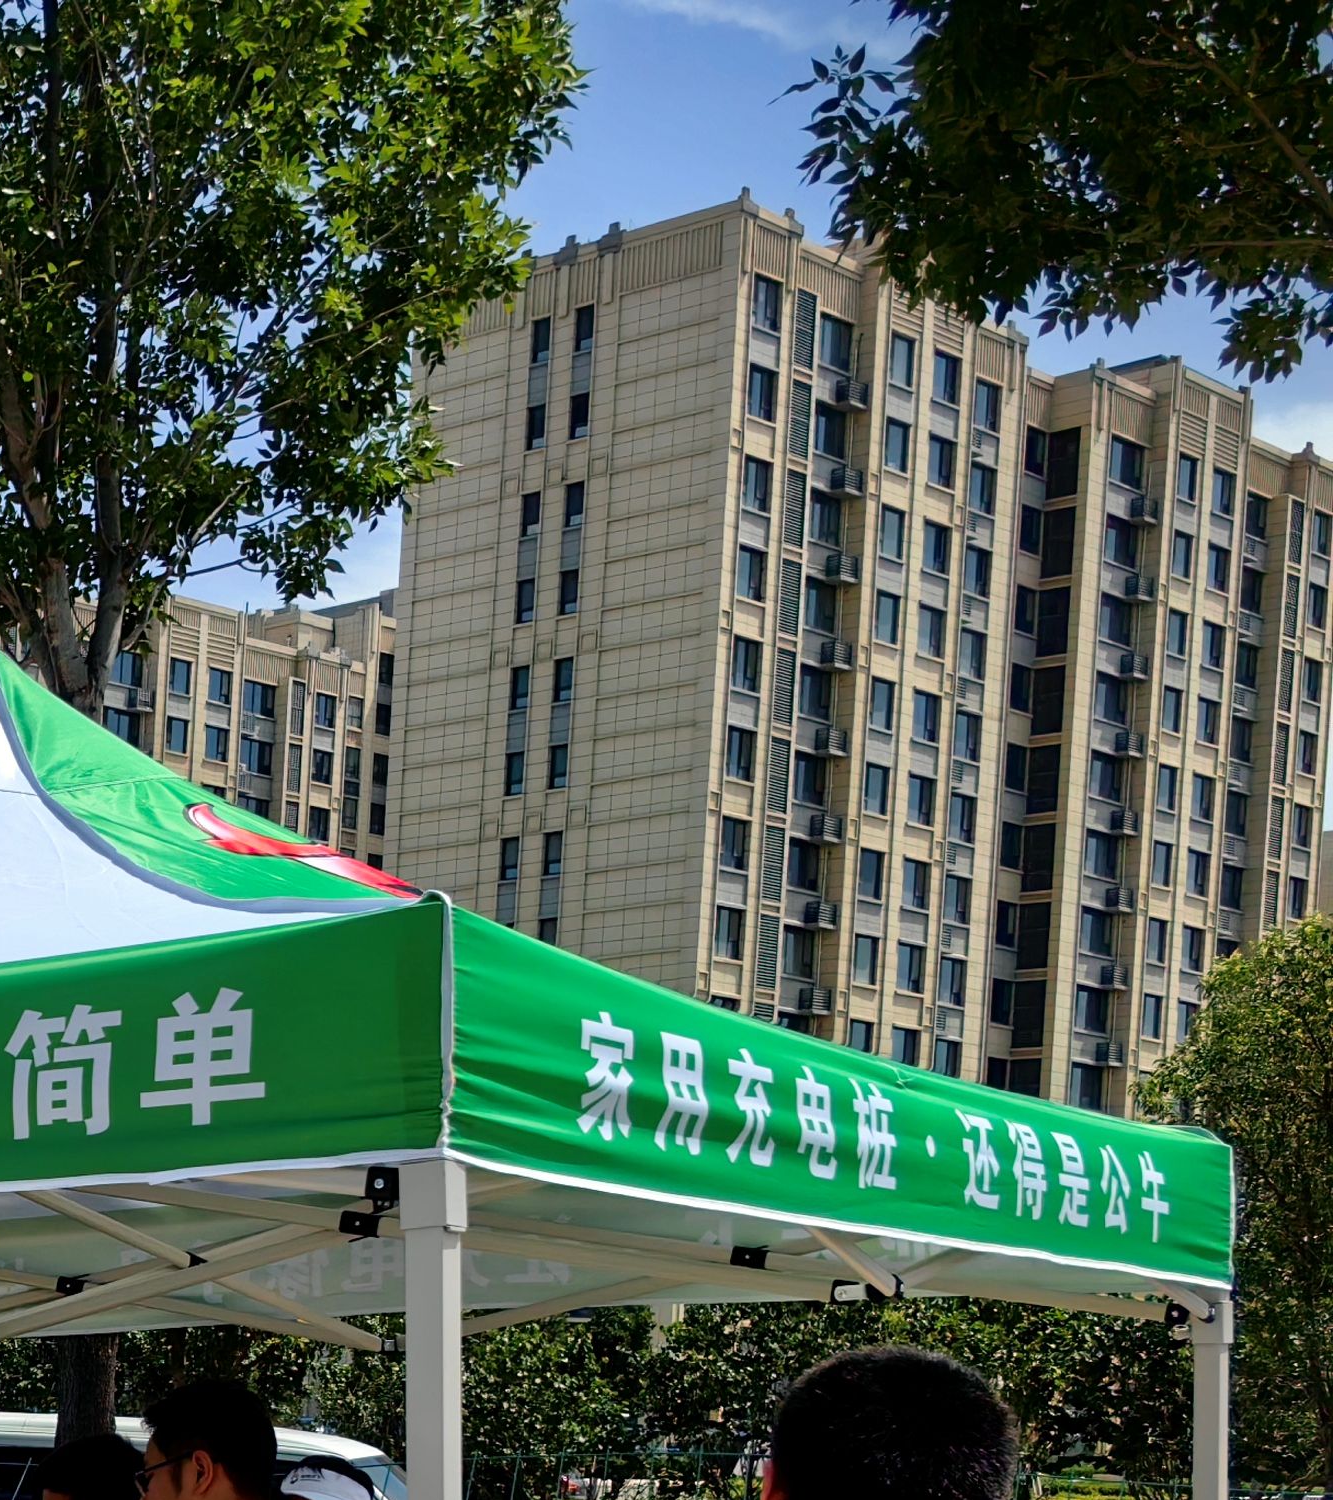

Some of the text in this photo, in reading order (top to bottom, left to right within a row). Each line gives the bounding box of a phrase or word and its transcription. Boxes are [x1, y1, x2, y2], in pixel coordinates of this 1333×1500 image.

[576, 1011, 1170, 1243] 家用充电桩·还得是公牛
